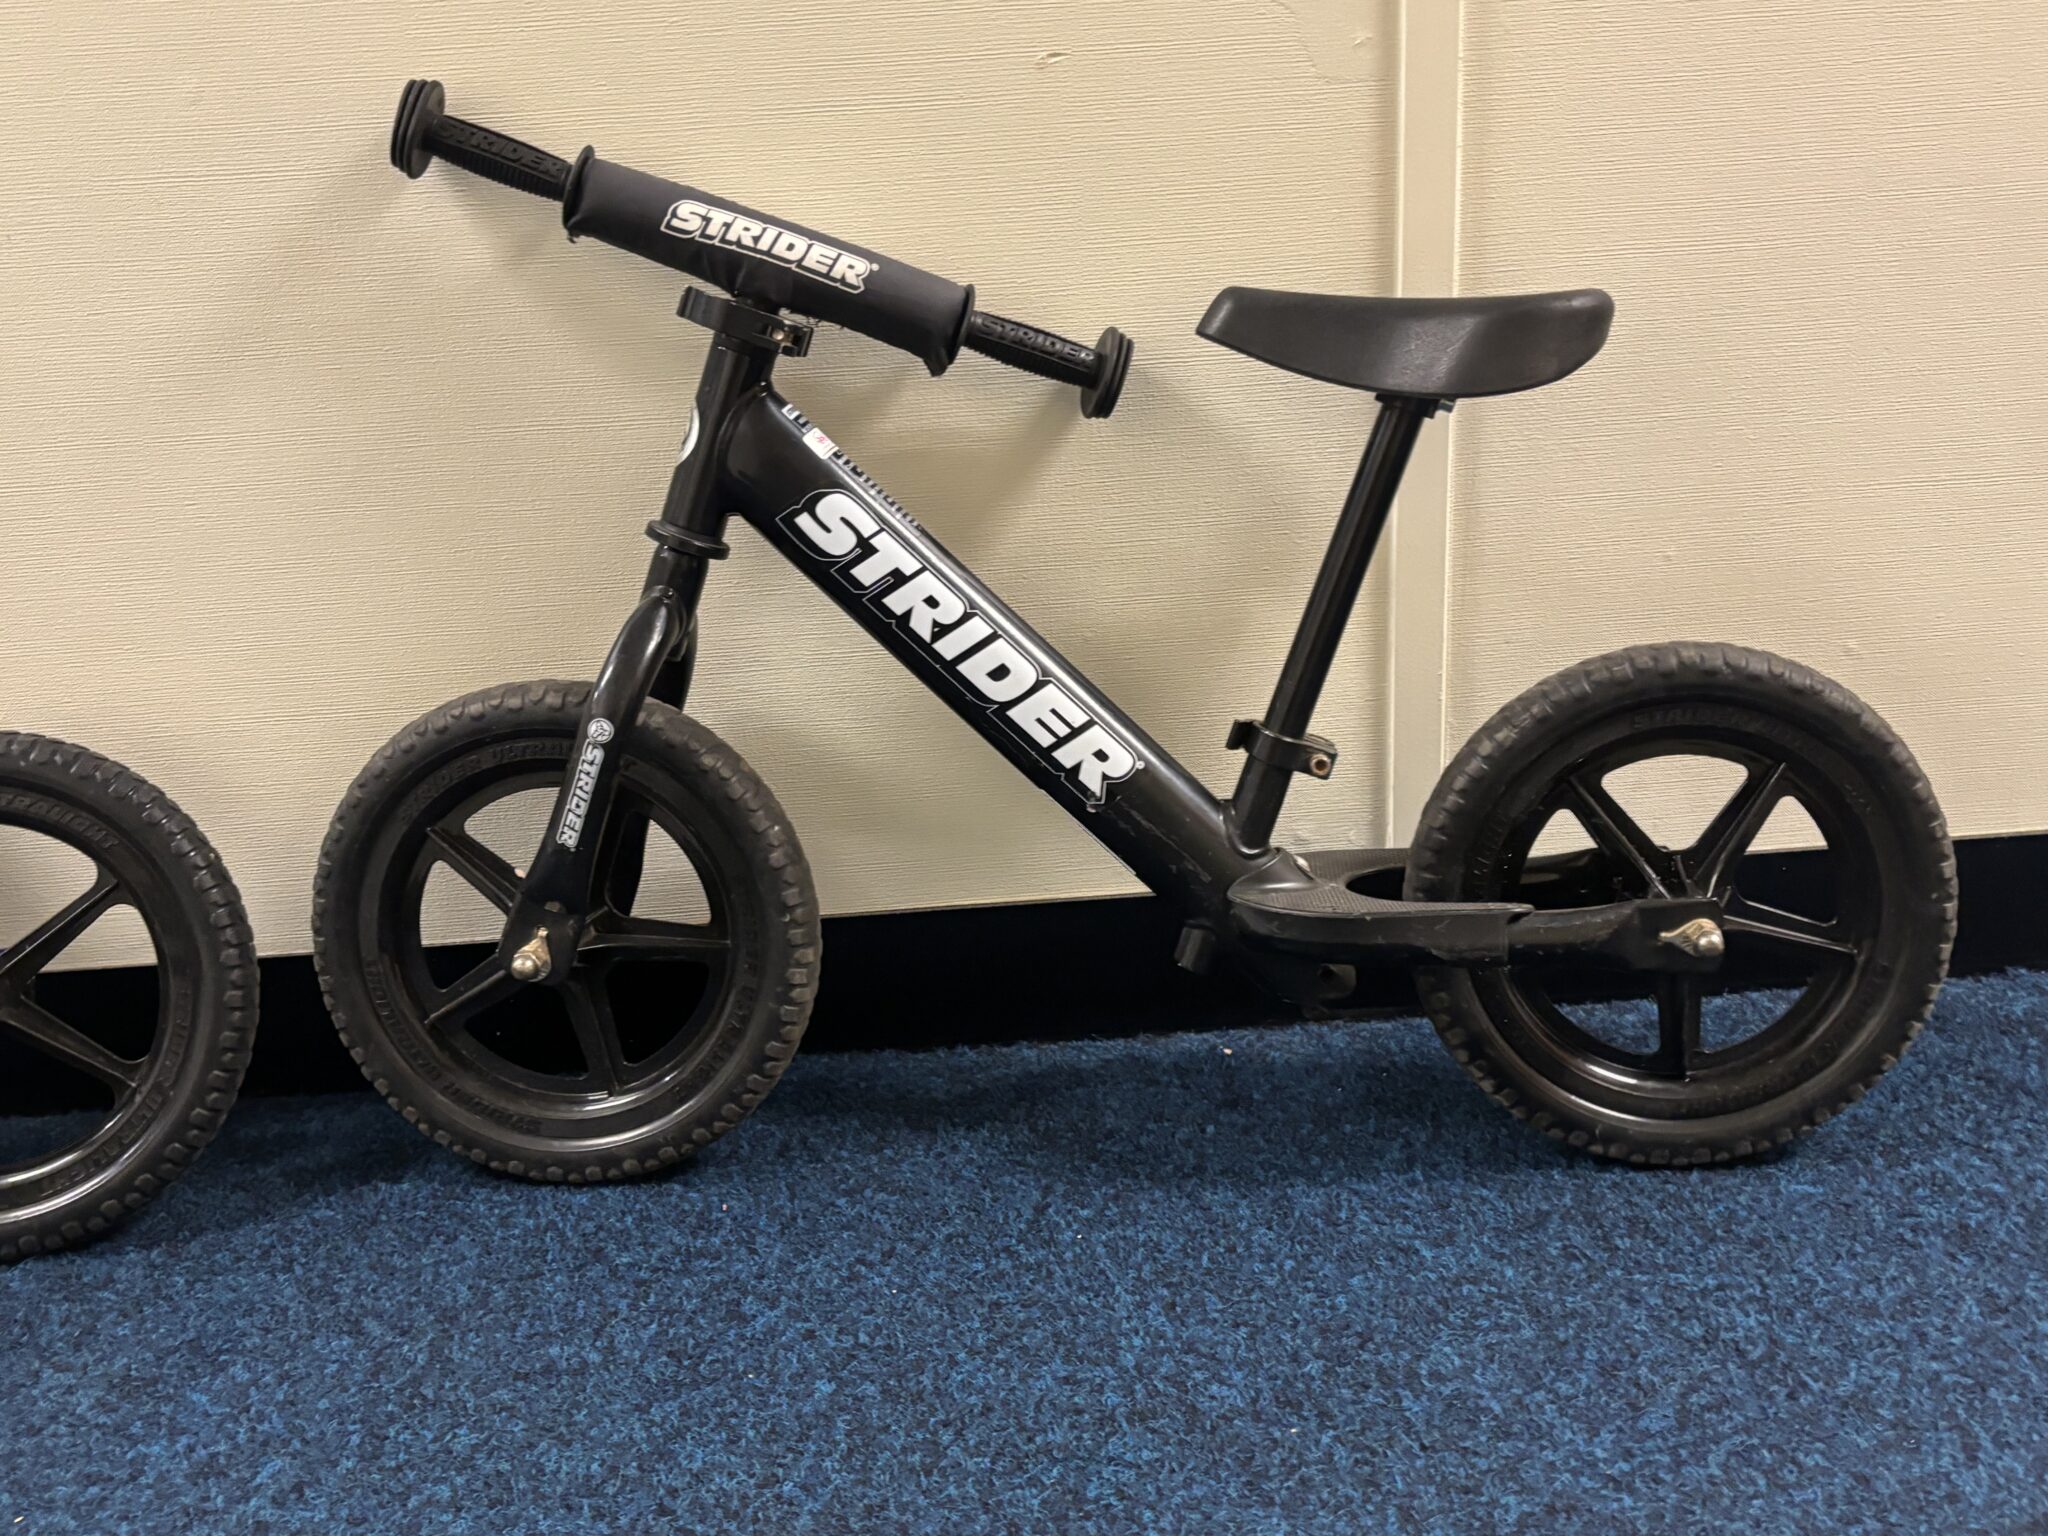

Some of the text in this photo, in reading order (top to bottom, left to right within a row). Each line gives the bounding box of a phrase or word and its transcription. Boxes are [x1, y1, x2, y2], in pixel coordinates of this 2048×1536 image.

[436, 121, 565, 179] STRIDER
[661, 200, 872, 293] STRIDER
[976, 315, 1096, 369] STRIDER
[786, 491, 1139, 799] STRIDER
[557, 741, 604, 848] STRIDER
